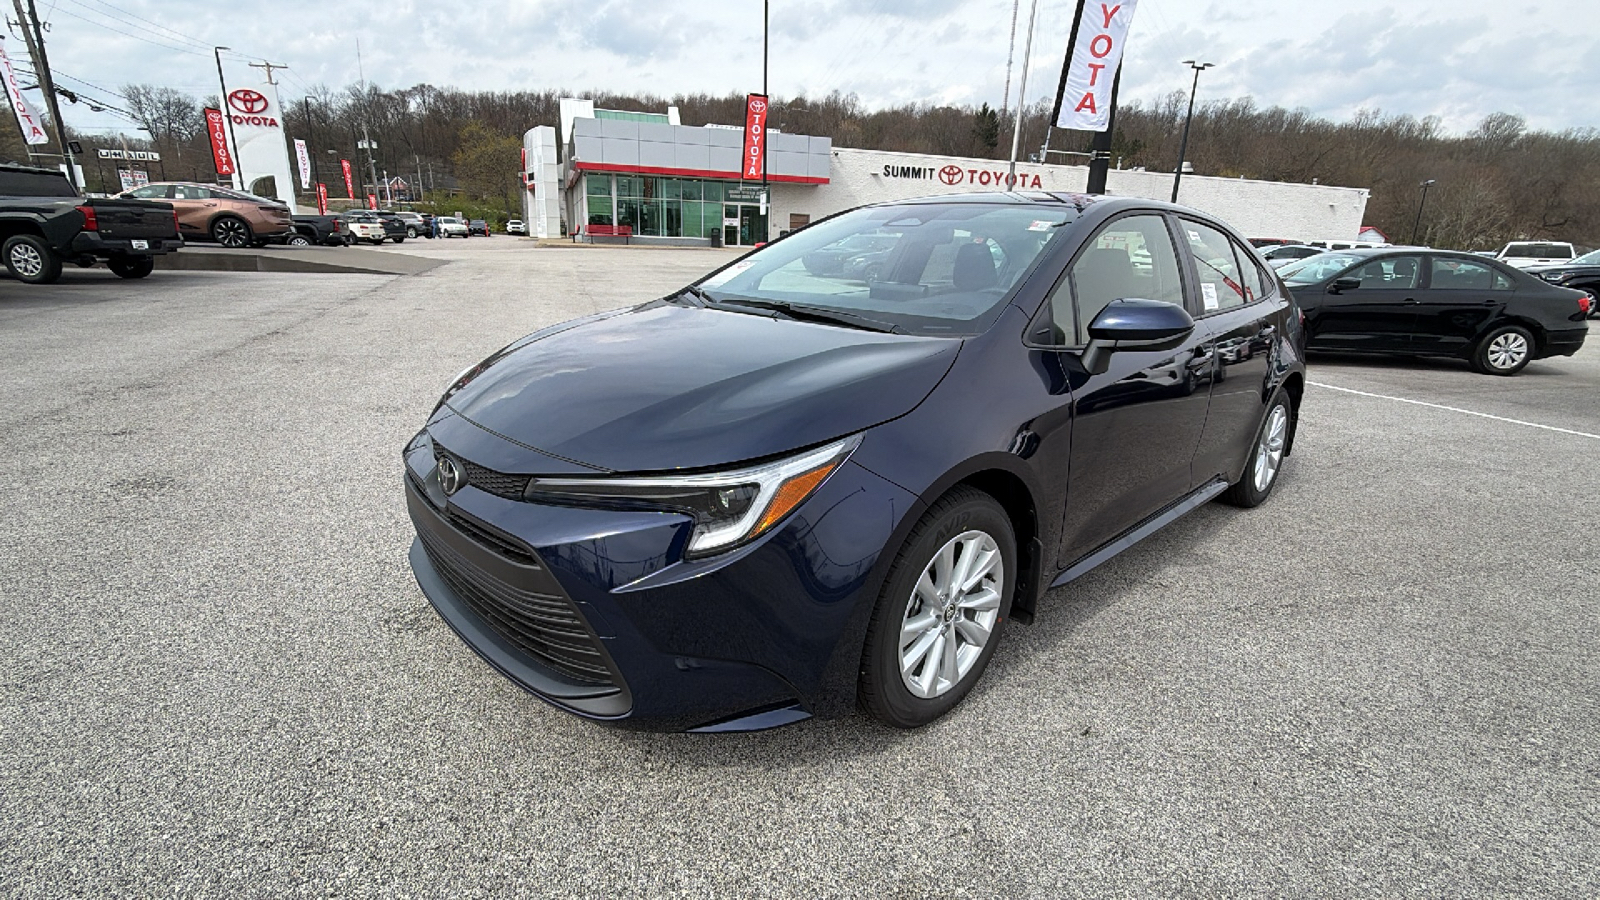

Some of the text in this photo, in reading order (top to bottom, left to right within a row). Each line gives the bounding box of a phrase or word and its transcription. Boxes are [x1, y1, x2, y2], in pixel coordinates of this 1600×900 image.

[4, 61, 43, 137] TOYOTA
[213, 123, 231, 172] TOYOTA
[748, 114, 761, 176] TOYOTA
[883, 164, 1042, 189] SUMMIT TOYOTA
